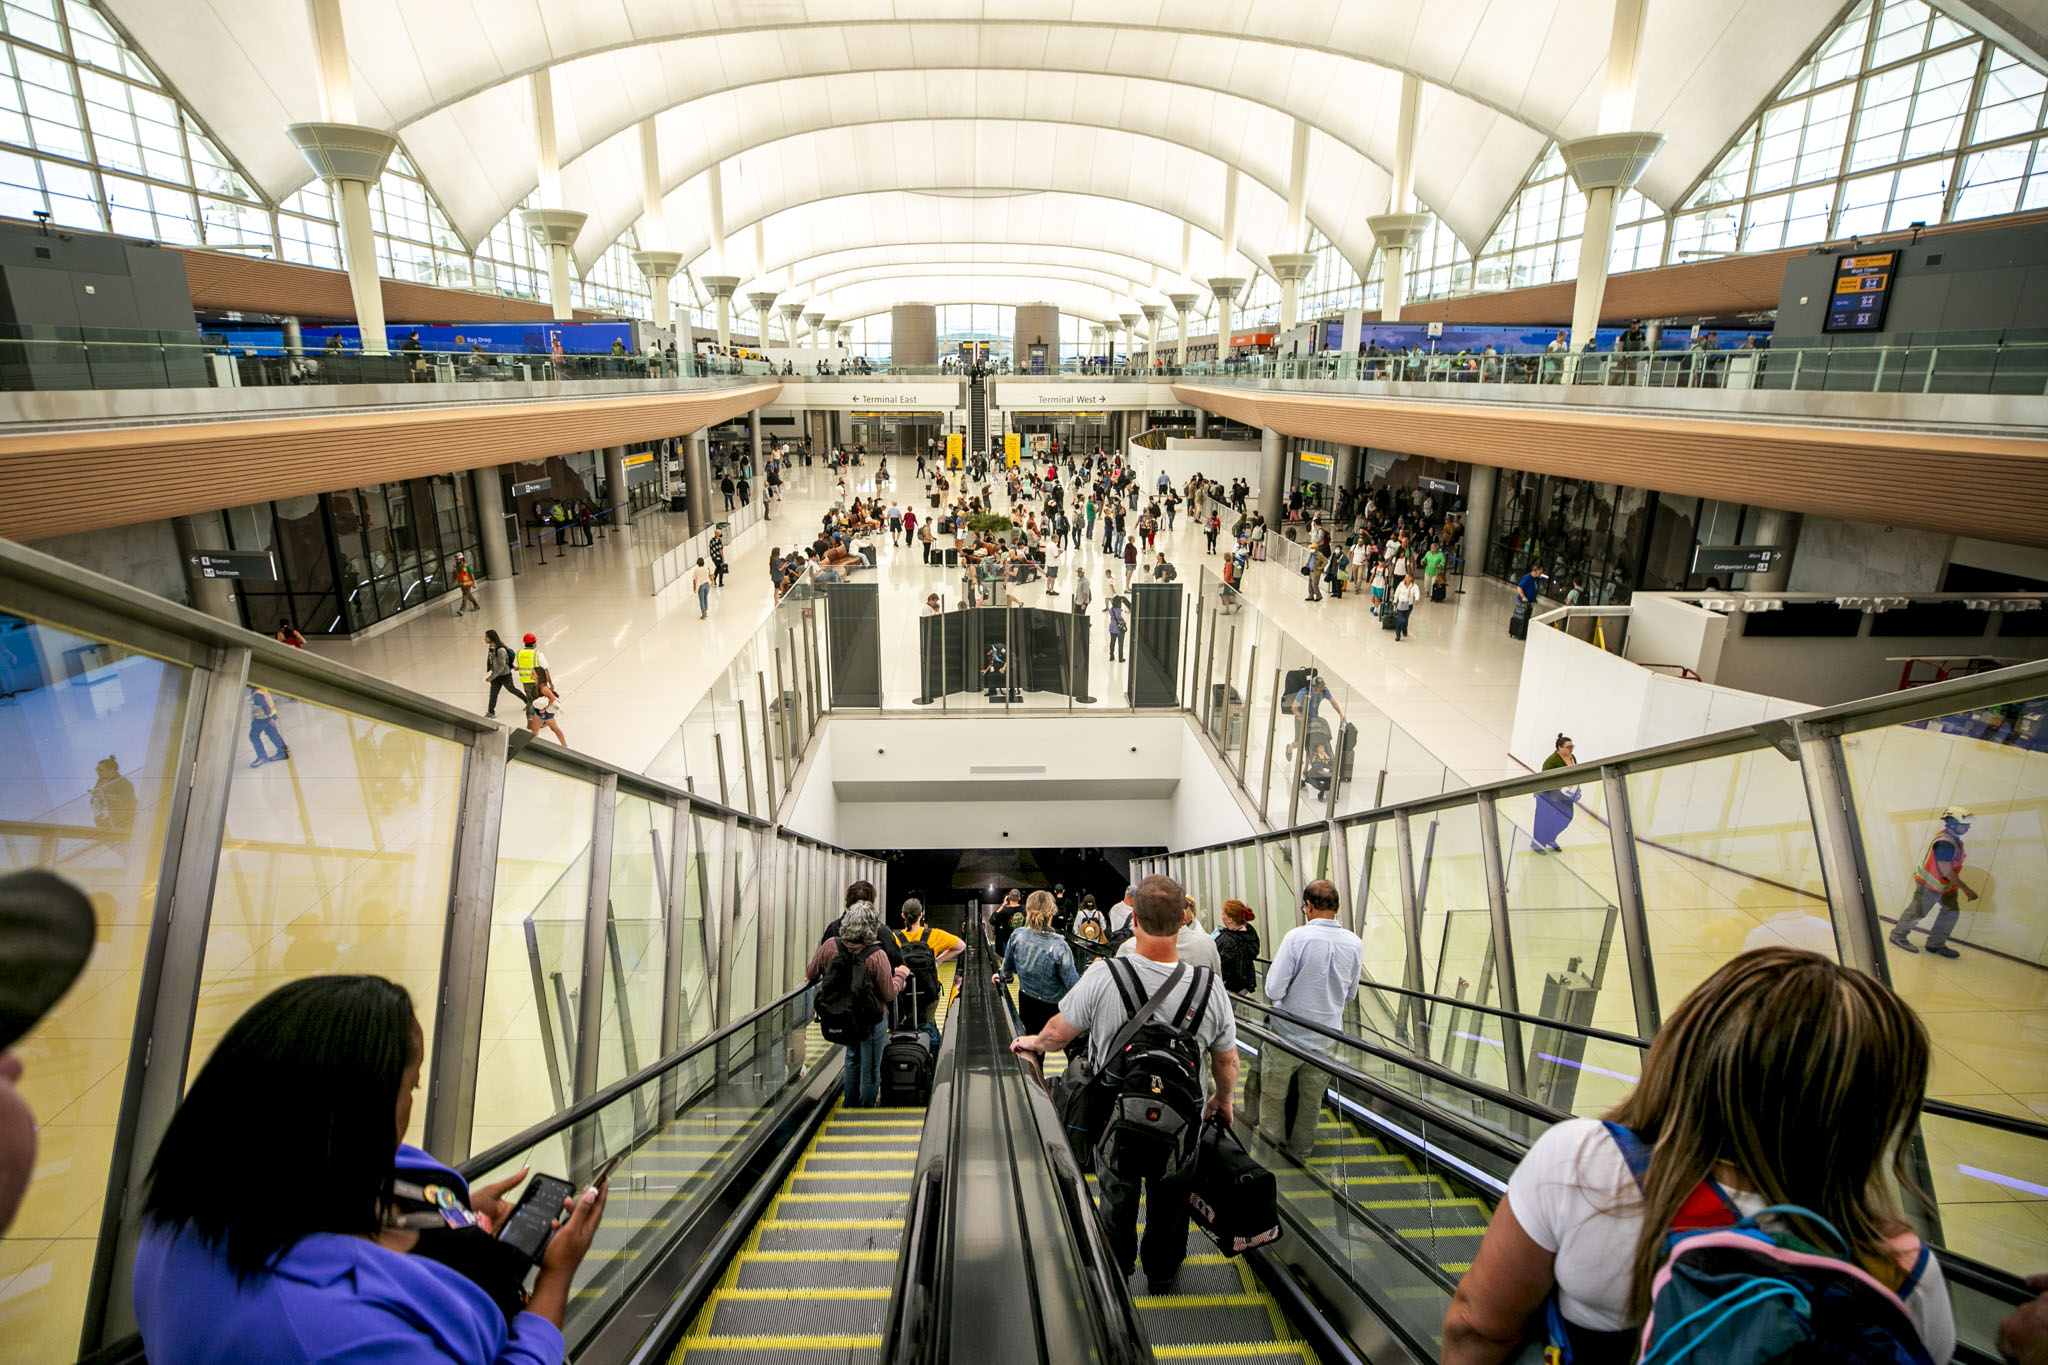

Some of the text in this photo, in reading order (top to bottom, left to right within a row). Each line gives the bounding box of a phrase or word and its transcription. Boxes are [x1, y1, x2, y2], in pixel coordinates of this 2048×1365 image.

[862, 395, 917, 404] Terminal East
[1038, 395, 1096, 404] Terminal West
